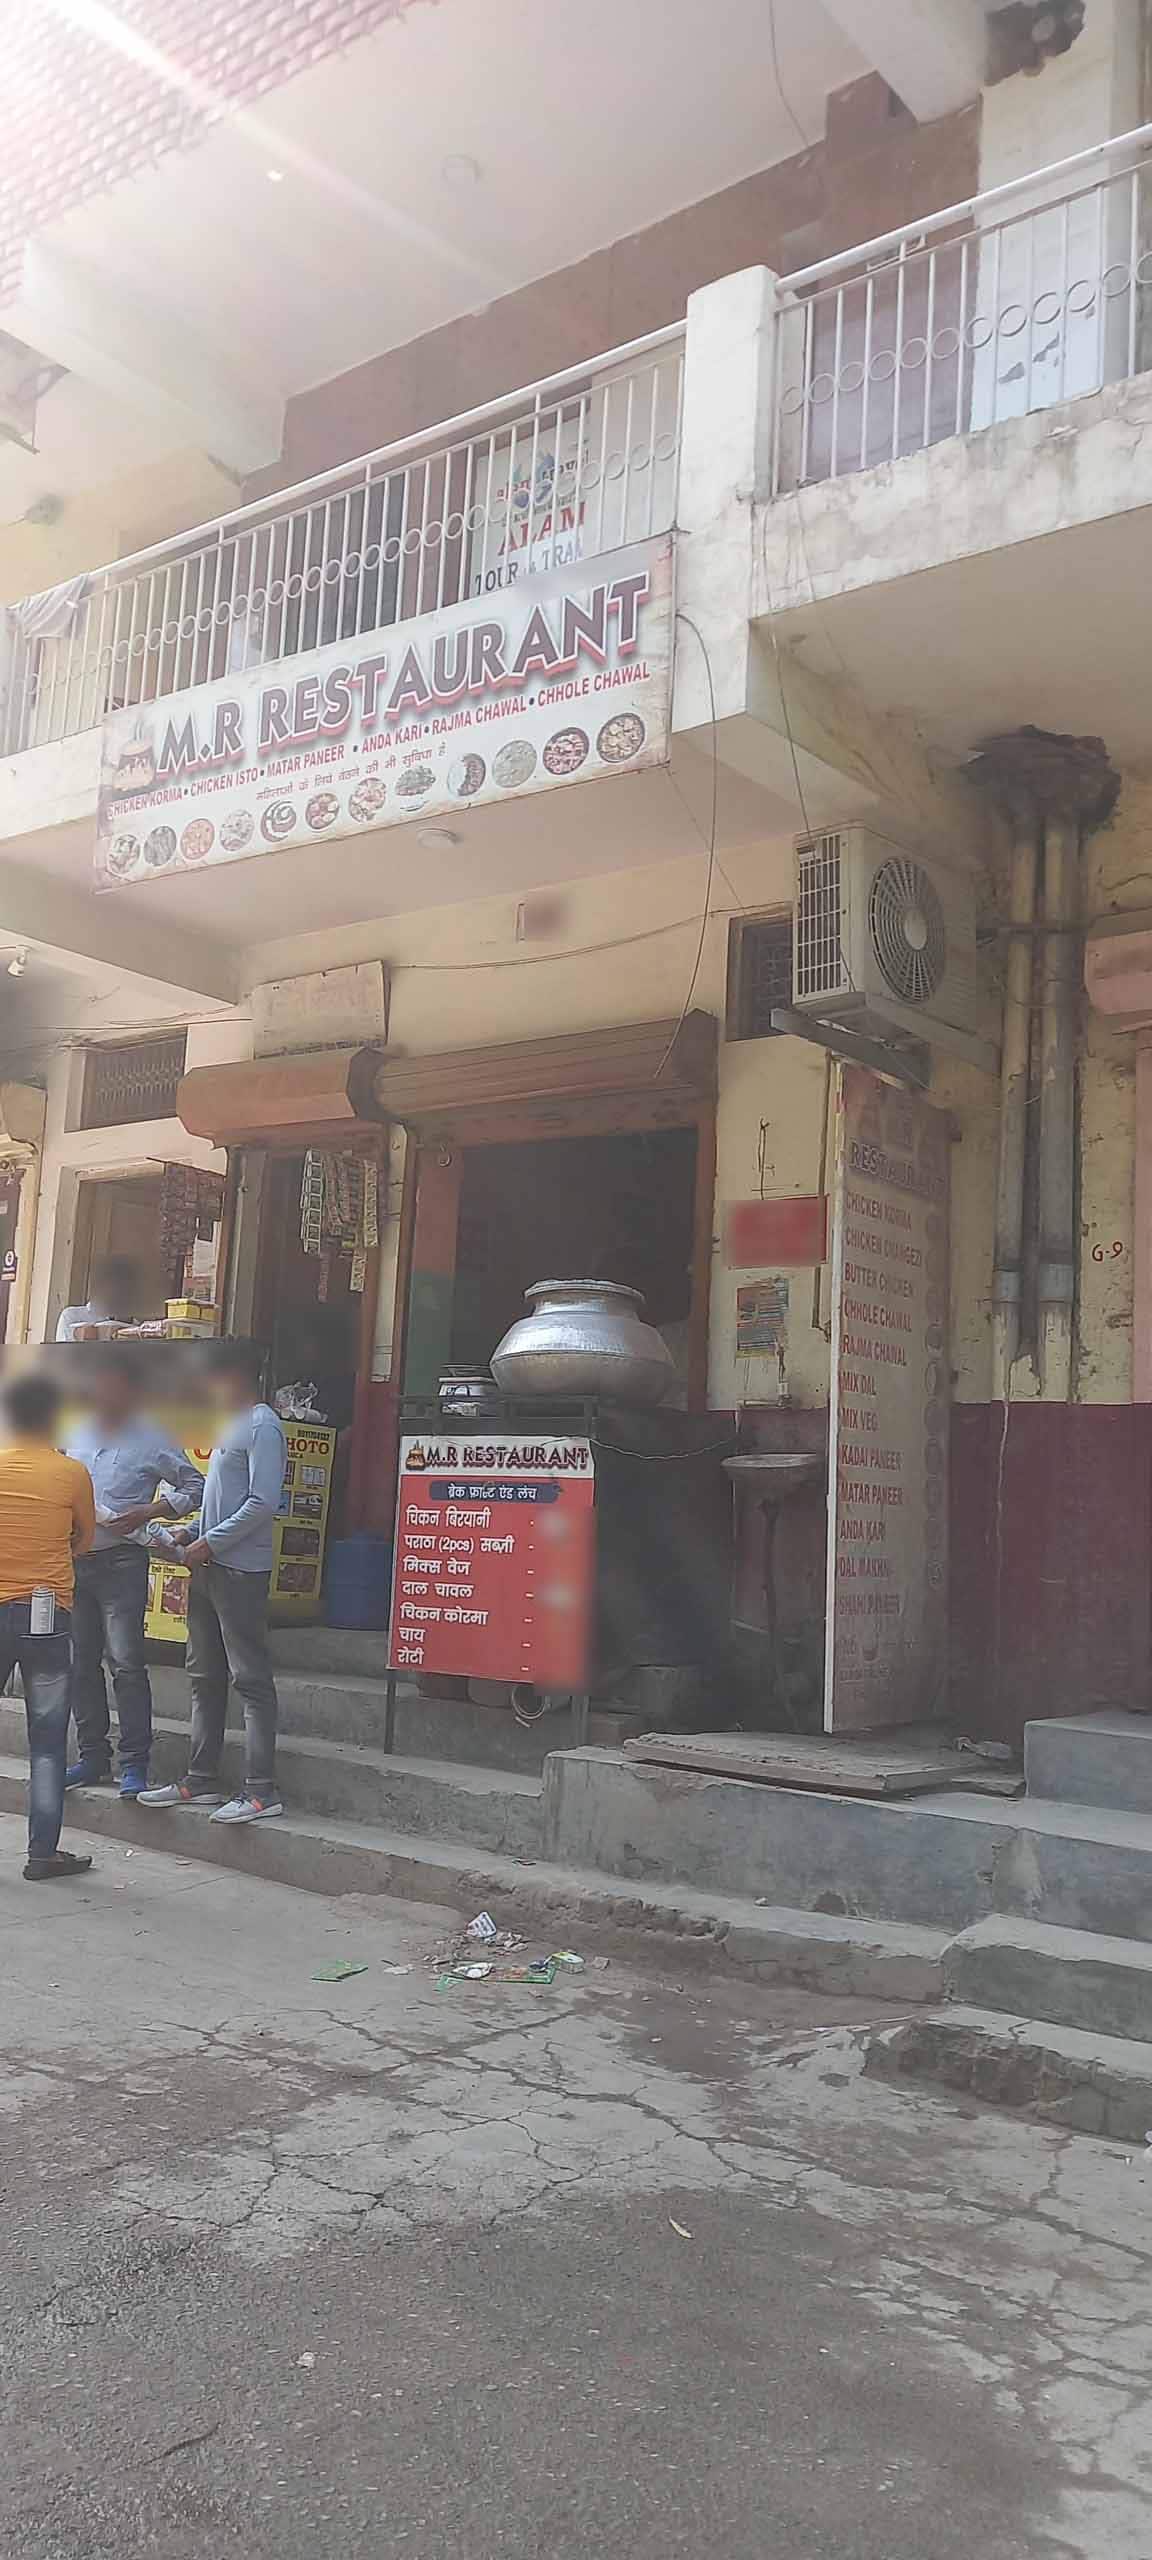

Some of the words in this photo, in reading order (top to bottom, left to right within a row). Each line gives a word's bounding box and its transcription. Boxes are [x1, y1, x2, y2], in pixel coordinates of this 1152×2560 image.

[498, 502, 586, 556] ALAM
[157, 700, 244, 776] M.R
[258, 572, 649, 752] RESTAURANT
[150, 788, 182, 808] KORMA
[190, 774, 234, 797] CHICKEN
[235, 767, 259, 788] ISTO
[266, 757, 301, 778] MATAR
[303, 744, 345, 771] PANEER
[362, 733, 391, 754] ANDA
[394, 724, 423, 744] KARI
[431, 710, 472, 736] RAJMA
[475, 697, 527, 724] CHAWAL
[537, 678, 589, 707] CHHOLE
[593, 661, 651, 692] CHAWAL
[845, 1226, 882, 1255] CHICKEN
[1092, 1241, 1123, 1262] G-9
[844, 1262, 878, 1290] BUTTER
[844, 1298, 879, 1326] CHHOLE
[880, 1307, 912, 1334] CHAWAL
[842, 1333, 873, 1359] RAJMA
[874, 1340, 907, 1367] CHAWAL
[840, 1374, 860, 1394] MIX
[860, 1377, 876, 1397] DAL
[841, 1408, 859, 1431] MIX
[860, 1409, 878, 1432] VEG
[426, 1446, 458, 1467] M.R
[462, 1446, 589, 1472] RESTAURANT
[841, 1444, 869, 1467] KADAI
[447, 1483, 466, 1499] ब्रेक
[499, 1484, 514, 1499] एंड
[517, 1485, 537, 1501] लंच
[839, 1482, 870, 1504] MATAR
[406, 1505, 440, 1526] चिकन
[445, 1506, 491, 1529] बिरयानी
[839, 1519, 865, 1540] ANDA
[403, 1534, 437, 1551] पराठा
[438, 1536, 474, 1555] (2pcs)
[403, 1556, 442, 1574] मिक्स
[447, 1557, 471, 1575] वेज
[839, 1556, 857, 1577] DAL
[402, 1581, 429, 1595] दाल
[435, 1583, 474, 1598] चावल
[400, 1602, 441, 1622] चिकन
[444, 1605, 488, 1626] कोरमा
[399, 1626, 425, 1643] चाय
[397, 1647, 424, 1665] रोटी
